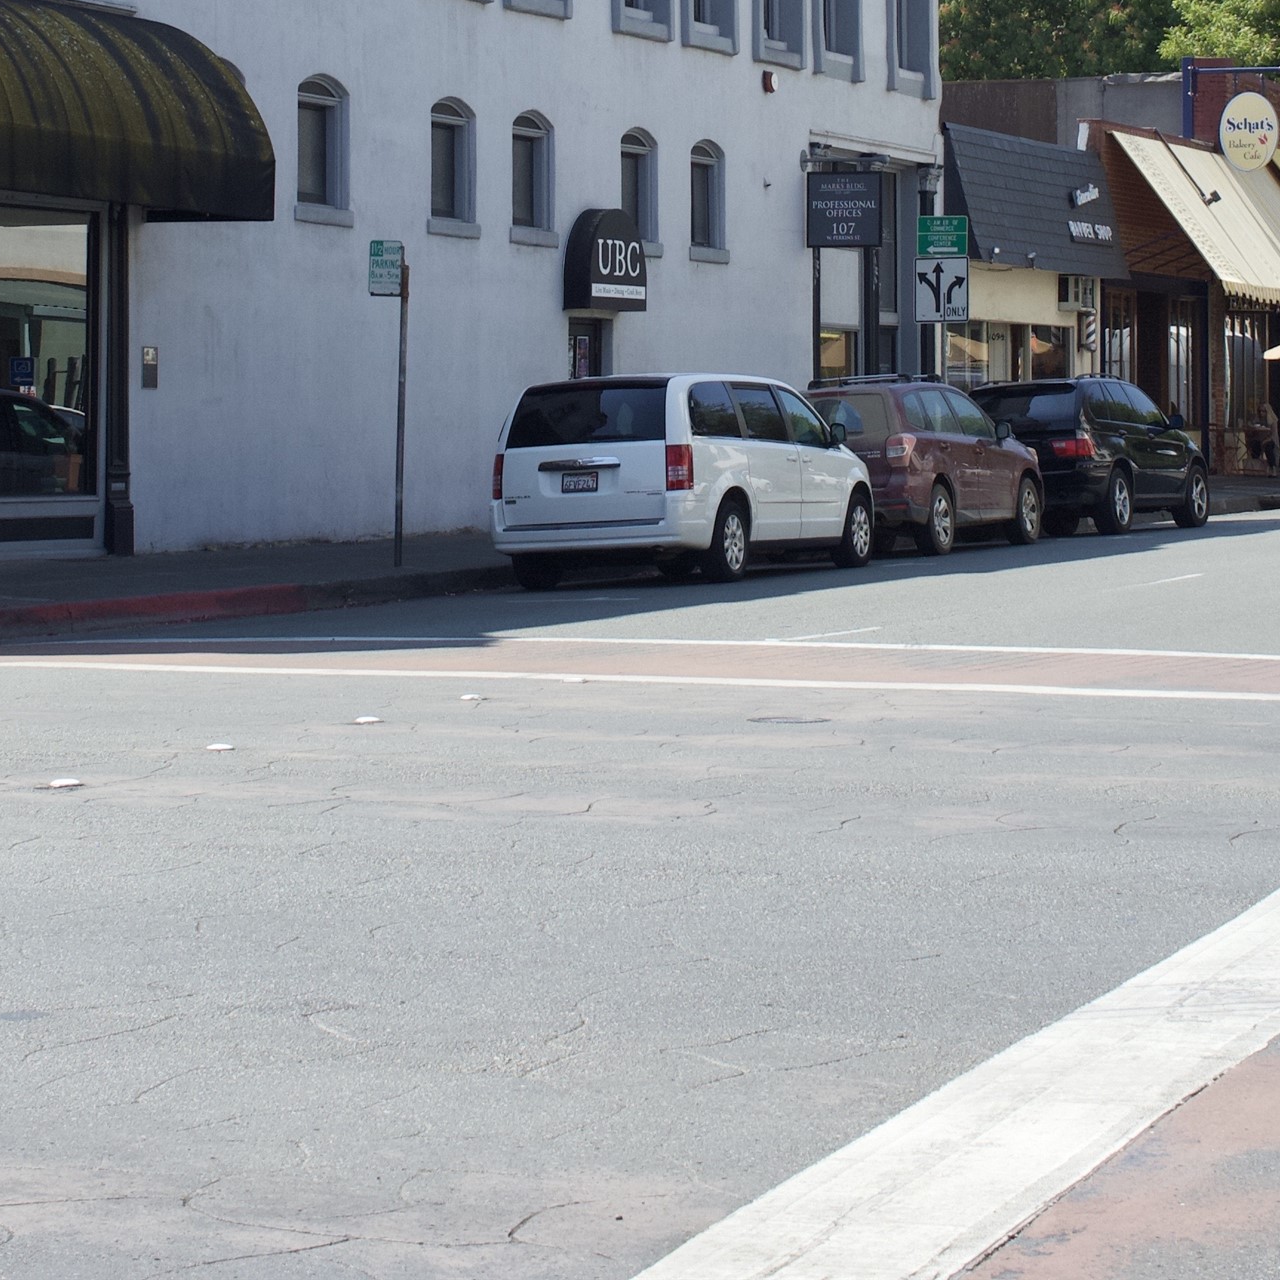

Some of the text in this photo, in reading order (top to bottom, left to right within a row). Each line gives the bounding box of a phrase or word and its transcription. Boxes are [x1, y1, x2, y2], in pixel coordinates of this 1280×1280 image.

[1225, 117, 1274, 134] Schat's
[1228, 139, 1256, 150] Bakery
[812, 200, 876, 209] PROFESSIONAL
[826, 209, 862, 217] OFFICES
[832, 222, 856, 235] 107
[597, 238, 640, 277] UBC
[371, 259, 400, 270] PARKING
[945, 306, 966, 317] ONLY
